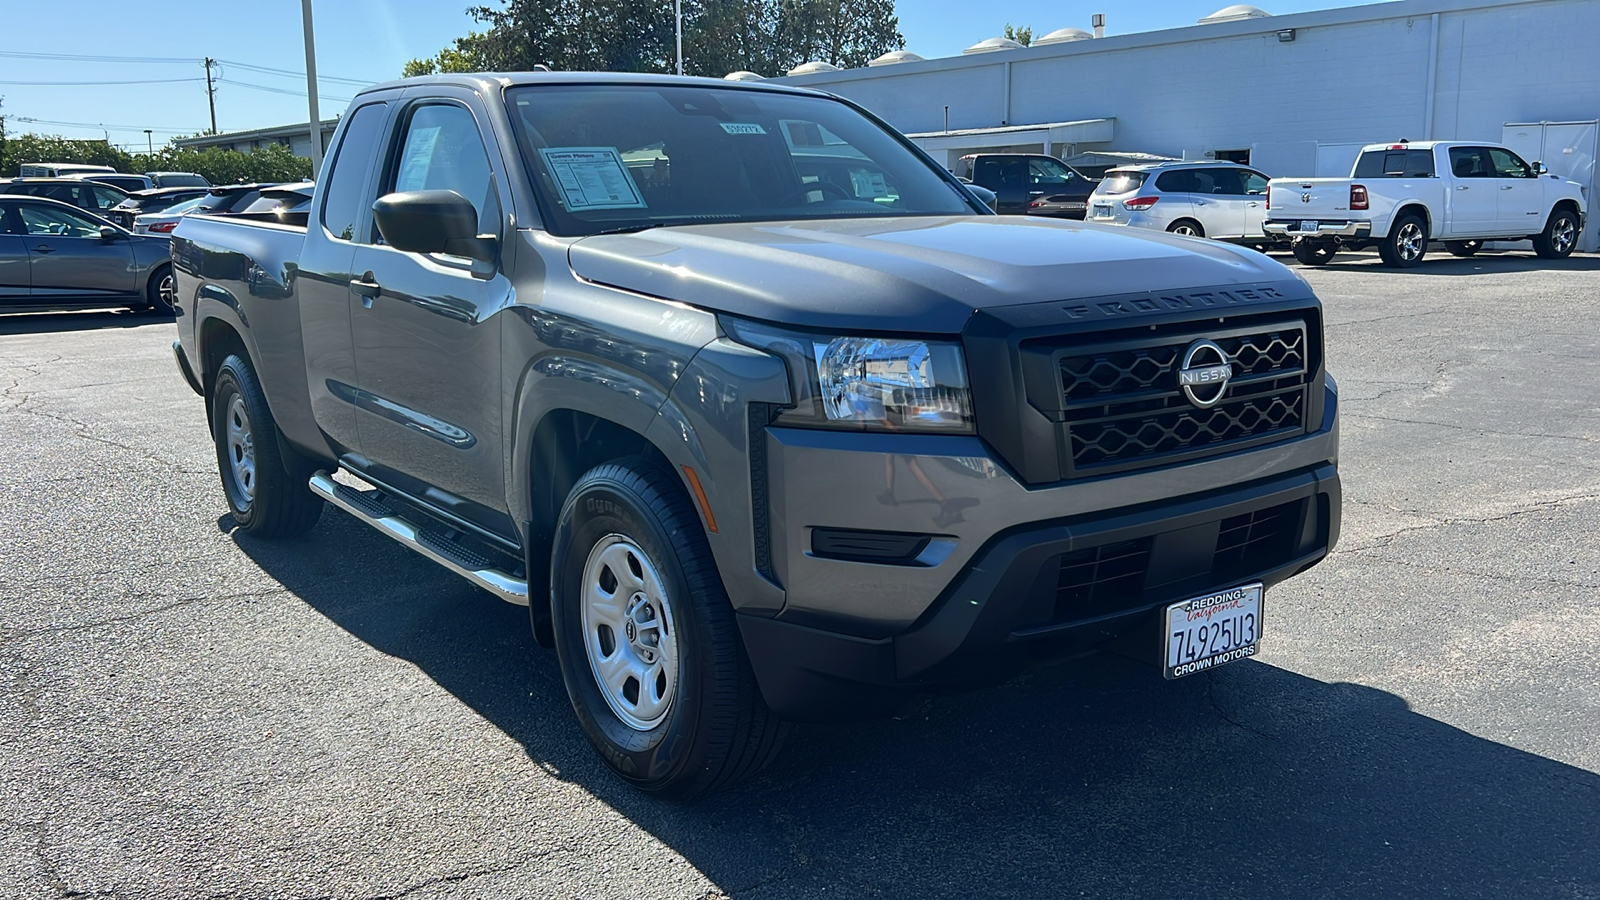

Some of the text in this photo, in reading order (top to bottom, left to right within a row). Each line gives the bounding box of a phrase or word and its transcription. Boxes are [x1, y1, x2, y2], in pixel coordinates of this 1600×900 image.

[1062, 288, 1284, 318] FRONTIER
[1181, 368, 1232, 383] NISSAN
[1187, 600, 1244, 622] California
[1191, 591, 1241, 611] REDDING
[1173, 613, 1255, 665] 74925U3
[1174, 645, 1255, 677] CROWN MOTORS
